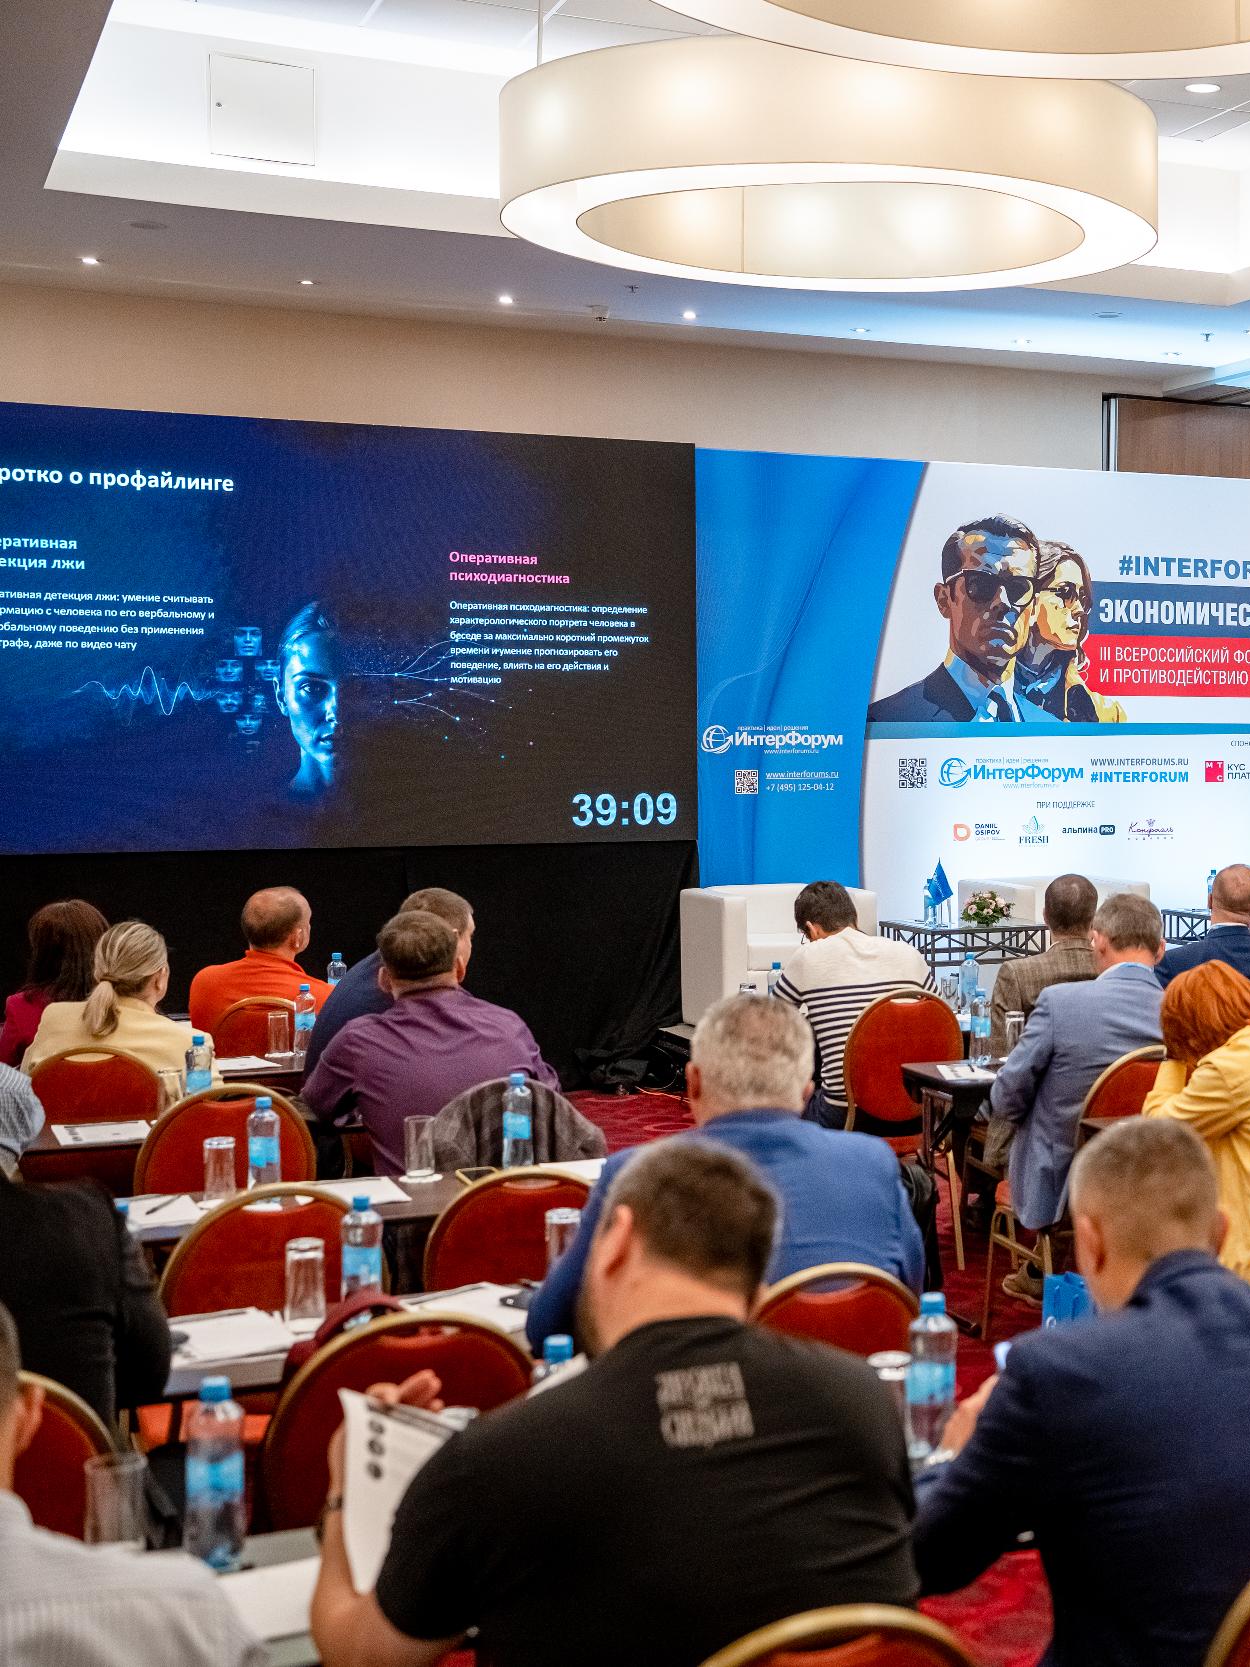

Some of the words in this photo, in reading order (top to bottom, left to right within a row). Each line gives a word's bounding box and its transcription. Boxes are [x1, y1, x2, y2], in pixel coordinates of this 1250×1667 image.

[0, 467, 63, 485] ротко
[70, 471, 83, 485] о
[89, 470, 235, 492] профайлинге
[0, 537, 77, 551] ративная
[0, 556, 47, 571] екция
[51, 559, 86, 570] лжи
[449, 551, 538, 565] Оперативная
[449, 572, 571, 585] психодиагностика
[0, 591, 42, 600] ативная
[44, 592, 92, 602] детекция
[95, 593, 120, 602] лжи:
[122, 594, 161, 603] умение
[162, 594, 214, 605] считывать
[0, 606, 44, 617] рмацию
[46, 608, 52, 616] с
[54, 608, 103, 617] человека
[104, 608, 118, 617] по
[119, 609, 137, 618] его
[138, 609, 206, 621] вербальному
[208, 611, 215, 620] и
[450, 600, 509, 612] Оперативная
[510, 603, 590, 614] психодиагностика:
[591, 605, 648, 615] определение
[450, 616, 548, 626] характерологического
[549, 619, 588, 628] портрета
[589, 620, 629, 629] человека
[0, 623, 57, 634] бальному
[59, 625, 119, 635] поведению
[120, 624, 139, 634] без
[140, 626, 205, 636] применения
[450, 630, 482, 642] беседе
[495, 633, 554, 642] максимально
[556, 633, 596, 643] короткий
[597, 635, 650, 645] промежуток
[0, 639, 33, 651] рафа,
[34, 640, 63, 650] даже
[65, 641, 79, 650] по
[81, 641, 113, 651] видео
[114, 641, 138, 652] чату
[450, 647, 490, 657] времени
[604, 649, 619, 657] его
[1099, 646, 1112, 661] III
[1115, 645, 1230, 665] ВСЕРОССИЙСКИЙ
[450, 661, 501, 671] поведение,
[503, 662, 533, 671] влиять
[534, 663, 545, 671] на
[547, 663, 561, 671] его
[562, 660, 602, 672] действия
[450, 676, 502, 687] мотивацию
[1099, 669, 1109, 684] И
[1113, 668, 1249, 687] ПРОТИВОДЕЙСТВИЮ
[735, 730, 843, 749] ИнтерФорум
[1090, 758, 1189, 767] WWW.INTERFORUMS.RU
[766, 770, 840, 780] www.interforums.ru
[973, 763, 1084, 783] ИнтерФорум
[1090, 771, 1189, 783] #INTERFORUM
[766, 784, 775, 792] +7
[776, 783, 796, 792] (495)
[798, 782, 835, 792] 125-04-12
[571, 792, 678, 827] 39:09
[1062, 826, 1098, 834] альпина
[1018, 835, 1049, 844] FRESH
